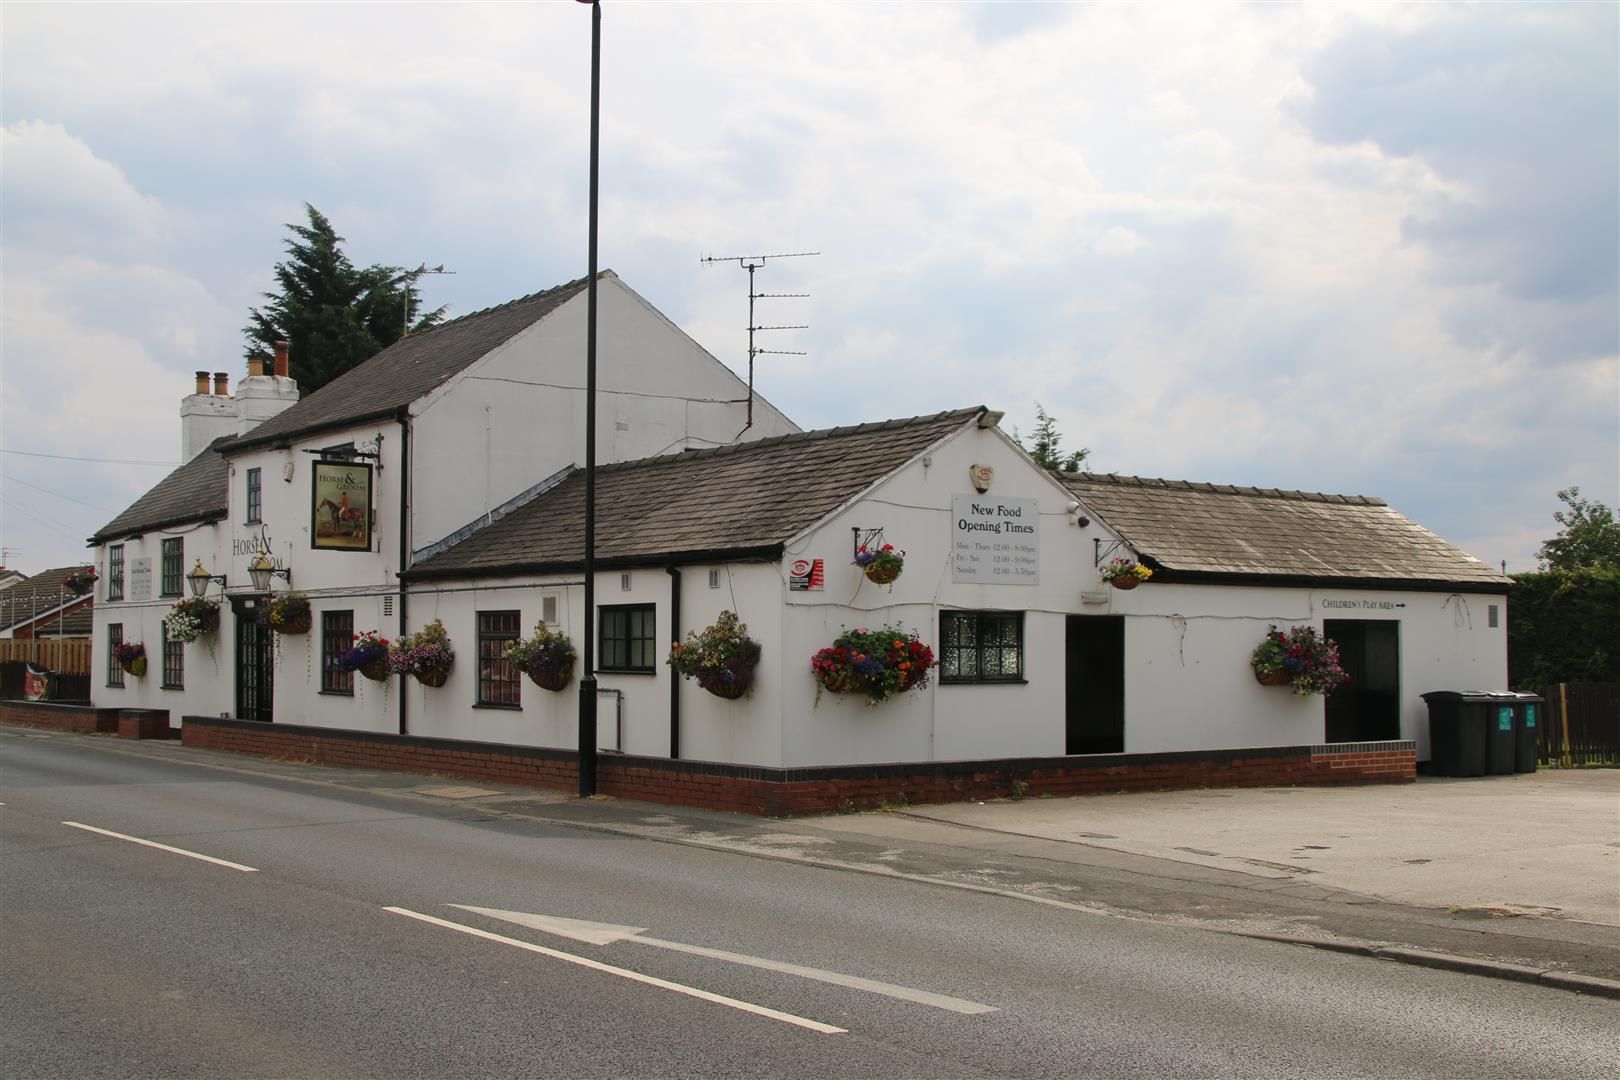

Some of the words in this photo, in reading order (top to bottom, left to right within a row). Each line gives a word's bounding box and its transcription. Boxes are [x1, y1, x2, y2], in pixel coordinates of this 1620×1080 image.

[319, 474, 345, 483] HORSE
[344, 471, 356, 485] &
[971, 503, 994, 516] New
[997, 505, 1021, 517] Food
[958, 519, 1001, 534] Opening
[1003, 521, 1034, 534] Times
[232, 536, 260, 557] HORSE
